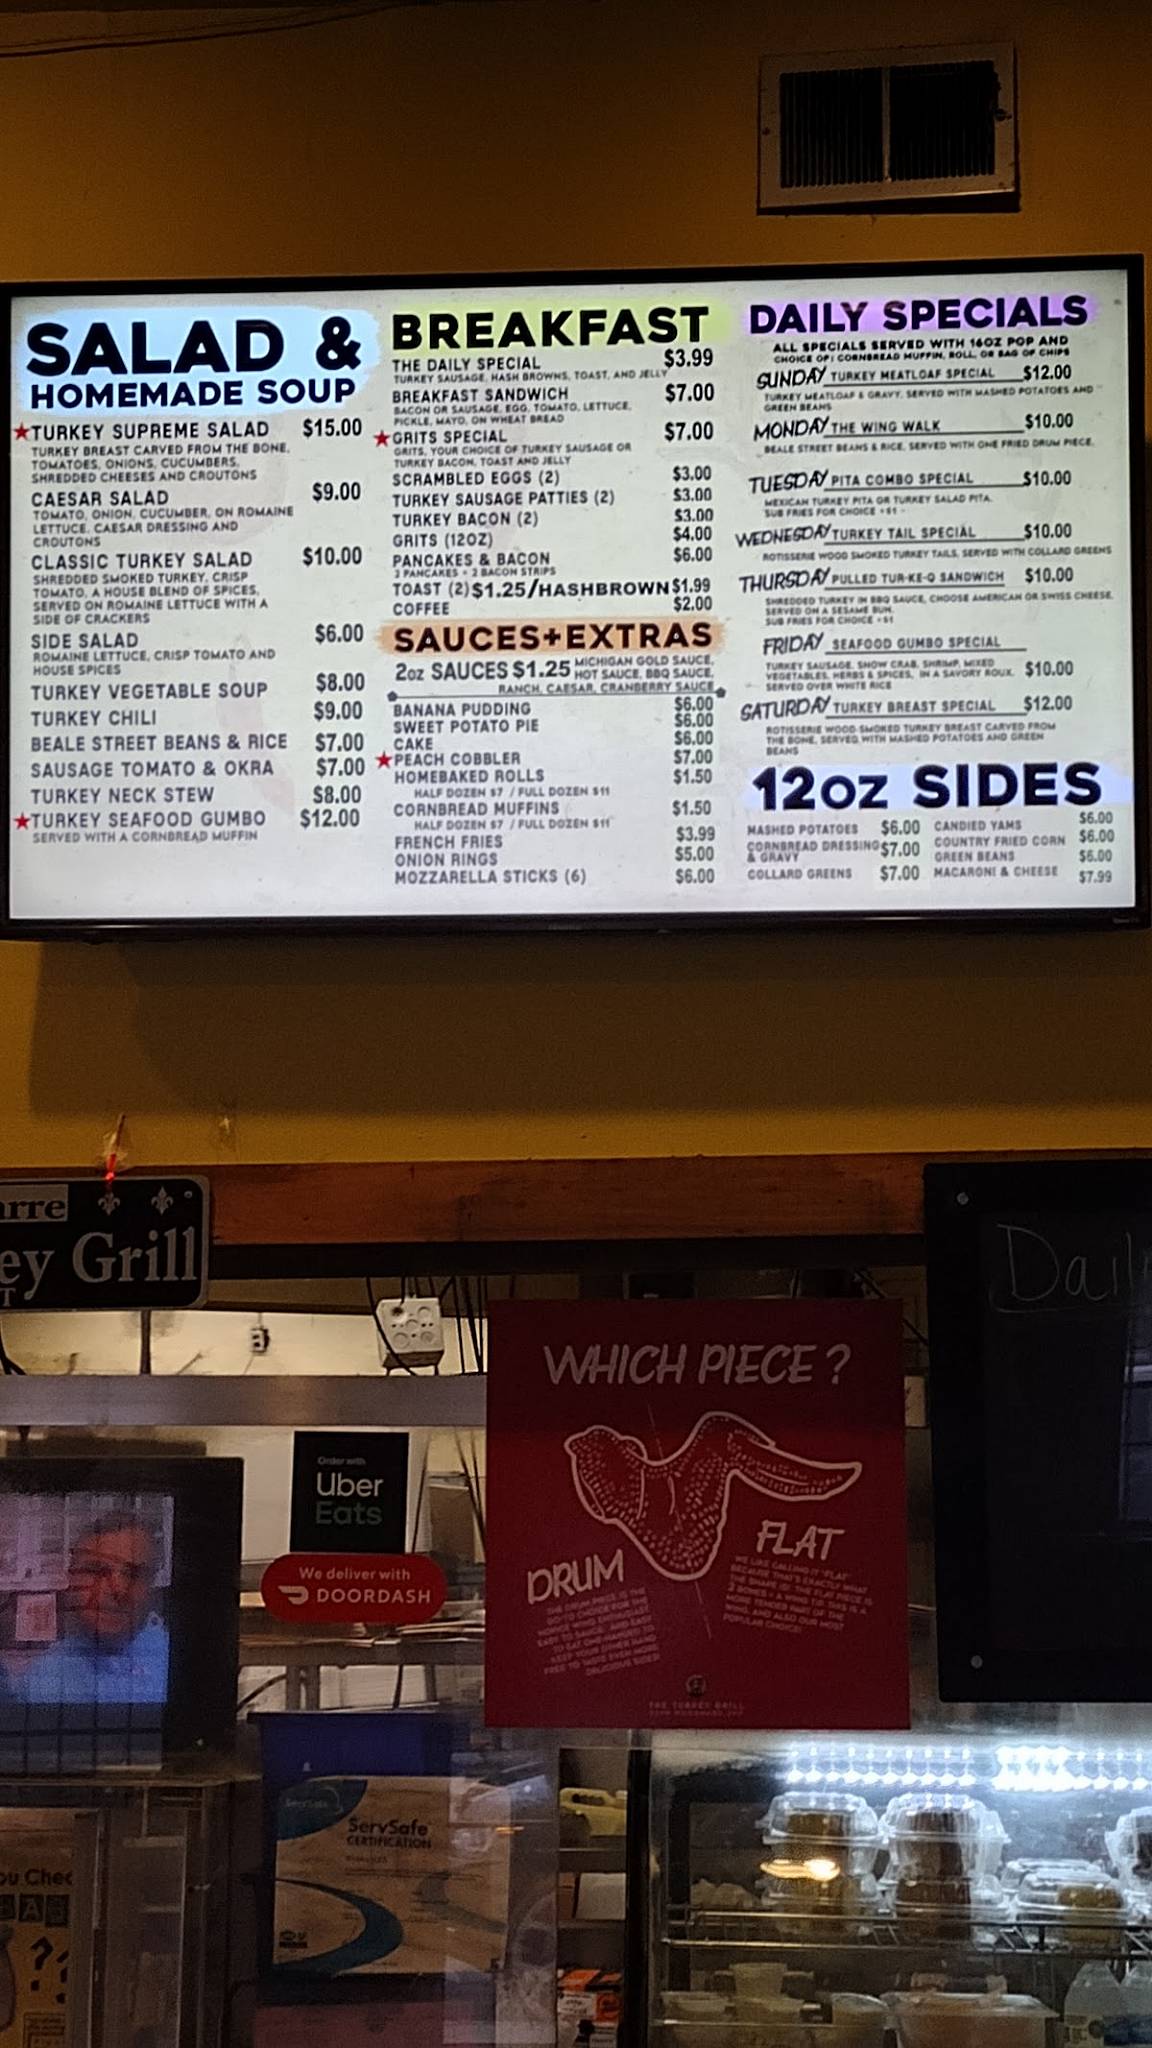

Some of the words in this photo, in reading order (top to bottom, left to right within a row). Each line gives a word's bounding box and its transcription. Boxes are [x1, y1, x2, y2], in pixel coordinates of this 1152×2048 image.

[750, 301, 868, 334] DAILY
[882, 294, 1088, 331] SPECIALS
[392, 305, 709, 351] BREAKFAST
[26, 318, 284, 377] SALAD
[315, 315, 361, 371] &
[391, 358, 420, 372] THE
[427, 357, 470, 372] DAILY
[477, 356, 540, 371] SPECIAL
[664, 347, 713, 369] $3.99
[756, 365, 826, 390] SUNDAY
[830, 370, 875, 382] TURKEY
[880, 368, 941, 380] MEATLOAF
[946, 367, 994, 379] SPECIAL
[1020, 363, 1072, 382] $12.00
[31, 379, 243, 409] HOMEMADE
[257, 377, 355, 404] SOUP
[392, 388, 478, 404] BREAKFAST
[484, 386, 568, 402] SANDWICH
[665, 382, 714, 403] $7.00
[302, 417, 362, 438] $15.00
[754, 416, 829, 442] MONDAY
[831, 421, 855, 436] THE
[860, 420, 897, 433] WING
[902, 420, 940, 435] WALK
[1025, 412, 1073, 429] $10.00
[28, 423, 104, 441] TURKEY
[112, 421, 198, 440] SUPREME
[207, 420, 268, 438] SALAD
[392, 430, 437, 445] GRITS
[443, 429, 507, 444] SPECIAL
[664, 421, 713, 442] $7.00
[31, 445, 79, 457] TURKEY
[83, 445, 129, 456] BREAST
[133, 444, 183, 456] CARVED
[187, 443, 222, 454] FROM
[225, 442, 248, 454] THE
[392, 471, 484, 487] SCRAMBLED
[491, 470, 531, 485] EGGS
[538, 470, 559, 486] (2)
[672, 464, 711, 482] $3.00
[749, 469, 829, 495] TUESDAY
[831, 474, 860, 486] PITA
[865, 473, 913, 486] COMBO
[919, 471, 973, 485] SPECIAL
[1020, 469, 1071, 487] $10.00
[31, 490, 101, 507] CAESAR
[109, 489, 168, 506] SALAD
[312, 481, 361, 502] $9.00
[392, 492, 449, 507] TURKEY
[455, 491, 522, 506] SAUSAGE
[528, 490, 588, 505] PATTIES
[594, 489, 614, 506] (2)
[673, 487, 712, 502] $3.00
[392, 512, 451, 527] TURKEY
[457, 511, 510, 526] BACON
[517, 511, 538, 527] (2)
[674, 507, 714, 522] $3.00
[392, 532, 437, 548] GRITS
[31, 553, 108, 570] CLASSIC
[115, 552, 185, 569] TURKEY
[192, 551, 252, 568] SALAD
[302, 545, 362, 567] $10.00
[739, 566, 832, 594] THURSDAY
[831, 573, 876, 585] PULLED
[940, 570, 1004, 583] SANDWICH
[31, 633, 71, 649] SIDE
[78, 632, 138, 649] SALAD
[315, 622, 363, 644] $6.00
[394, 621, 712, 653] SAUCES+EXTRAS
[431, 660, 508, 681] SAUCES
[512, 659, 570, 679] $1.25
[574, 668, 598, 680] HOT
[645, 667, 670, 680] BBQ
[30, 684, 101, 701] TURKEY
[107, 682, 210, 700] VEGETABLE
[218, 681, 267, 698] SOUP
[315, 671, 364, 693] $8.00
[30, 710, 101, 727] TURKEY
[108, 709, 156, 726] CHILI
[313, 699, 362, 722] $9.00
[393, 703, 456, 717] BANANA
[461, 701, 531, 716] PUDDING
[31, 735, 85, 752] BEALE
[91, 734, 156, 751] STREET
[163, 734, 220, 751] BEANS
[226, 733, 240, 749] &
[247, 733, 287, 749] RICE
[315, 731, 364, 752] $7.00
[391, 752, 444, 767] PEACH
[450, 751, 520, 766] COBBLER
[673, 748, 713, 765] $7.00
[30, 761, 113, 778] SAUSAGE
[120, 760, 195, 777] TOMATO
[202, 760, 216, 776] &
[224, 759, 273, 776] OKRA
[316, 756, 365, 778] $7.00
[312, 784, 361, 804] $8.00
[913, 761, 1101, 809] SIDES
[30, 787, 100, 804] TURKEY
[108, 787, 156, 803] NECK
[163, 786, 214, 803] STEW
[29, 811, 101, 828] TURKEY
[108, 811, 192, 828] SEAFOOD
[200, 810, 265, 827] GUMBO
[299, 807, 359, 829] $12.00
[934, 819, 986, 832] CANDIED
[990, 819, 1022, 831] YAMS
[32, 831, 80, 844] SERVED
[83, 831, 115, 842] WITH
[119, 831, 128, 842] A
[131, 830, 208, 843] CORNBREAD
[211, 829, 257, 841] MUFFIN
[746, 824, 794, 836] MASHED
[798, 823, 858, 835] POTATOES
[394, 869, 497, 884] MOZZARELLA
[503, 868, 557, 883] STICKS
[564, 868, 586, 885] (6)
[72, 1225, 198, 1284] Grill
[544, 1343, 688, 1385] WHICH
[699, 1343, 818, 1385] PIECE
[826, 1343, 851, 1385] ?
[317, 1456, 345, 1466] Order
[346, 1456, 367, 1466] with
[316, 1471, 384, 1497] Uber
[315, 1500, 383, 1526] Eats
[756, 1519, 846, 1561] FLAT
[299, 1566, 323, 1580] We
[326, 1566, 376, 1580] deliver
[379, 1567, 411, 1581] with
[527, 1548, 624, 1604] DRUM
[316, 1588, 431, 1604] DOORDASH
[347, 1817, 428, 1836] ServSafe
[346, 1835, 432, 1849] CERTIFICATION
